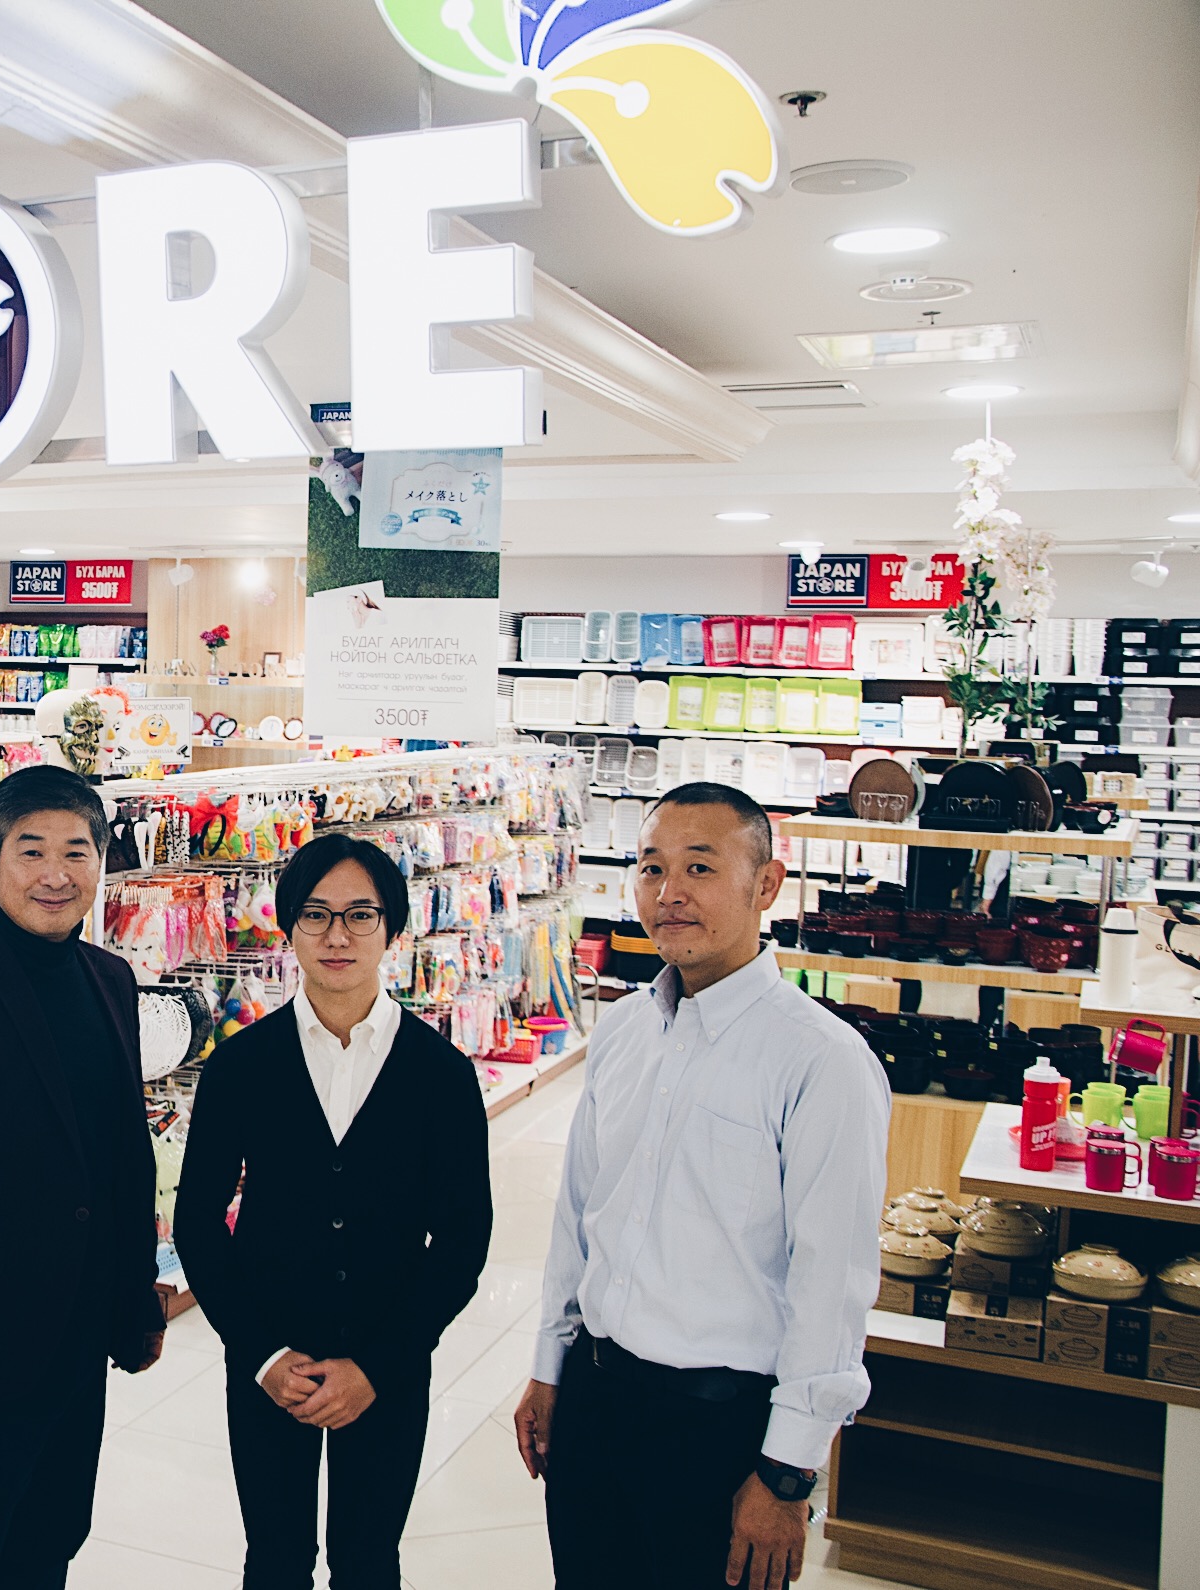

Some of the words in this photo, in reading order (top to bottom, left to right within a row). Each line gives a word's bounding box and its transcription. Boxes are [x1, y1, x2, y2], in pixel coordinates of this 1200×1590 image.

[321, 411, 351, 420] JAPAN
[404, 490, 468, 504] メイク落とし
[16, 567, 61, 579] JAPAN
[76, 566, 94, 578] БҮХ
[96, 566, 125, 578] БАРАА
[795, 563, 861, 578] JAPAN
[17, 579, 57, 592] STORE
[797, 577, 855, 594] STORE
[342, 635, 384, 649] БУДАГ
[390, 637, 459, 650] АРИЛГАГЧ
[330, 649, 386, 664] НОЙТОН
[394, 652, 477, 666] САЛЬФЕТКА
[374, 708, 429, 727] 3500₮
